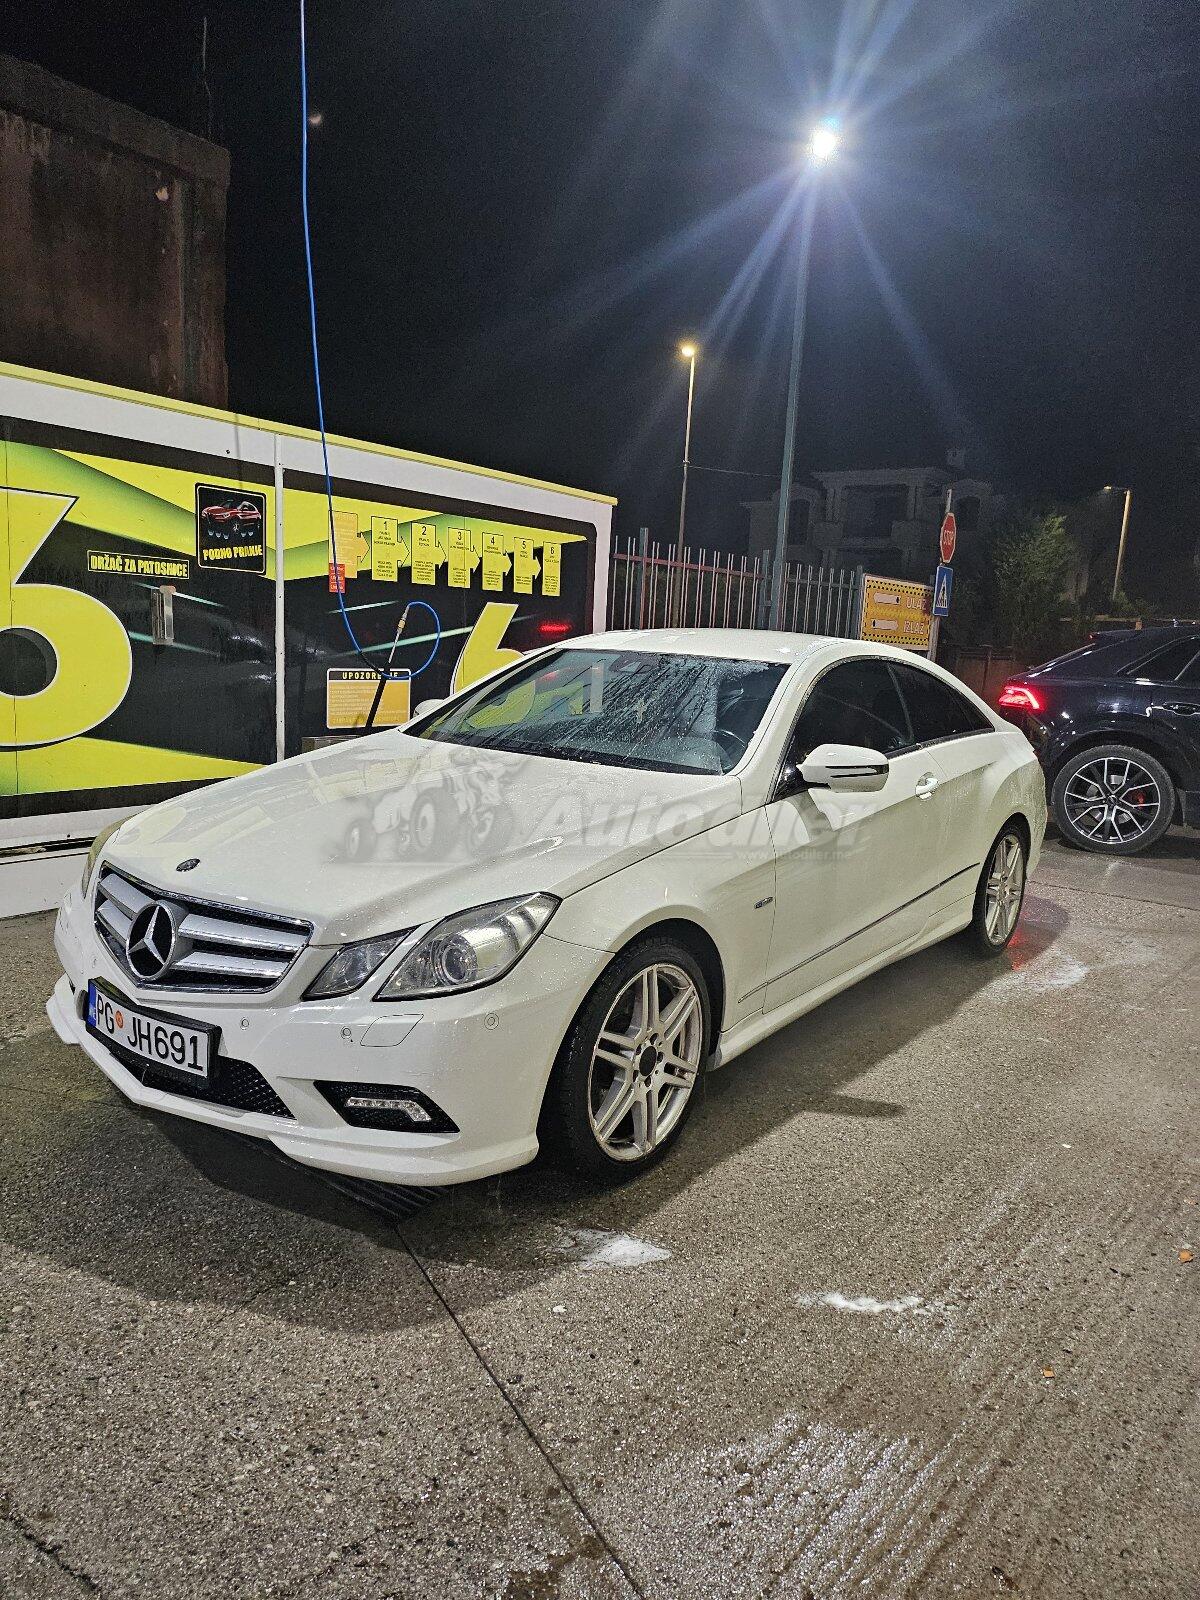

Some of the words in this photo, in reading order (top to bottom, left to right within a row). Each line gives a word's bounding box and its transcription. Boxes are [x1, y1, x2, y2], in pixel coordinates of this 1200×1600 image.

[383, 521, 388, 530] 1
[421, 525, 427, 536] 2
[457, 531, 462, 540] 3
[490, 536, 495, 545] 4
[943, 529, 953, 545] STOP
[522, 540, 527, 550] 5
[550, 546, 555, 555] 6
[203, 547, 232, 560] PODNO
[233, 545, 263, 558] PRANJE
[90, 554, 122, 572] DRŽAČ
[124, 558, 136, 572] ZA
[138, 560, 187, 577] PATOSNICE
[906, 596, 927, 610] ULAZ
[903, 620, 924, 634] IZLAZ
[342, 671, 399, 680] UPOZOREJE
[97, 994, 115, 1034] PG
[127, 1017, 203, 1071] JH691
